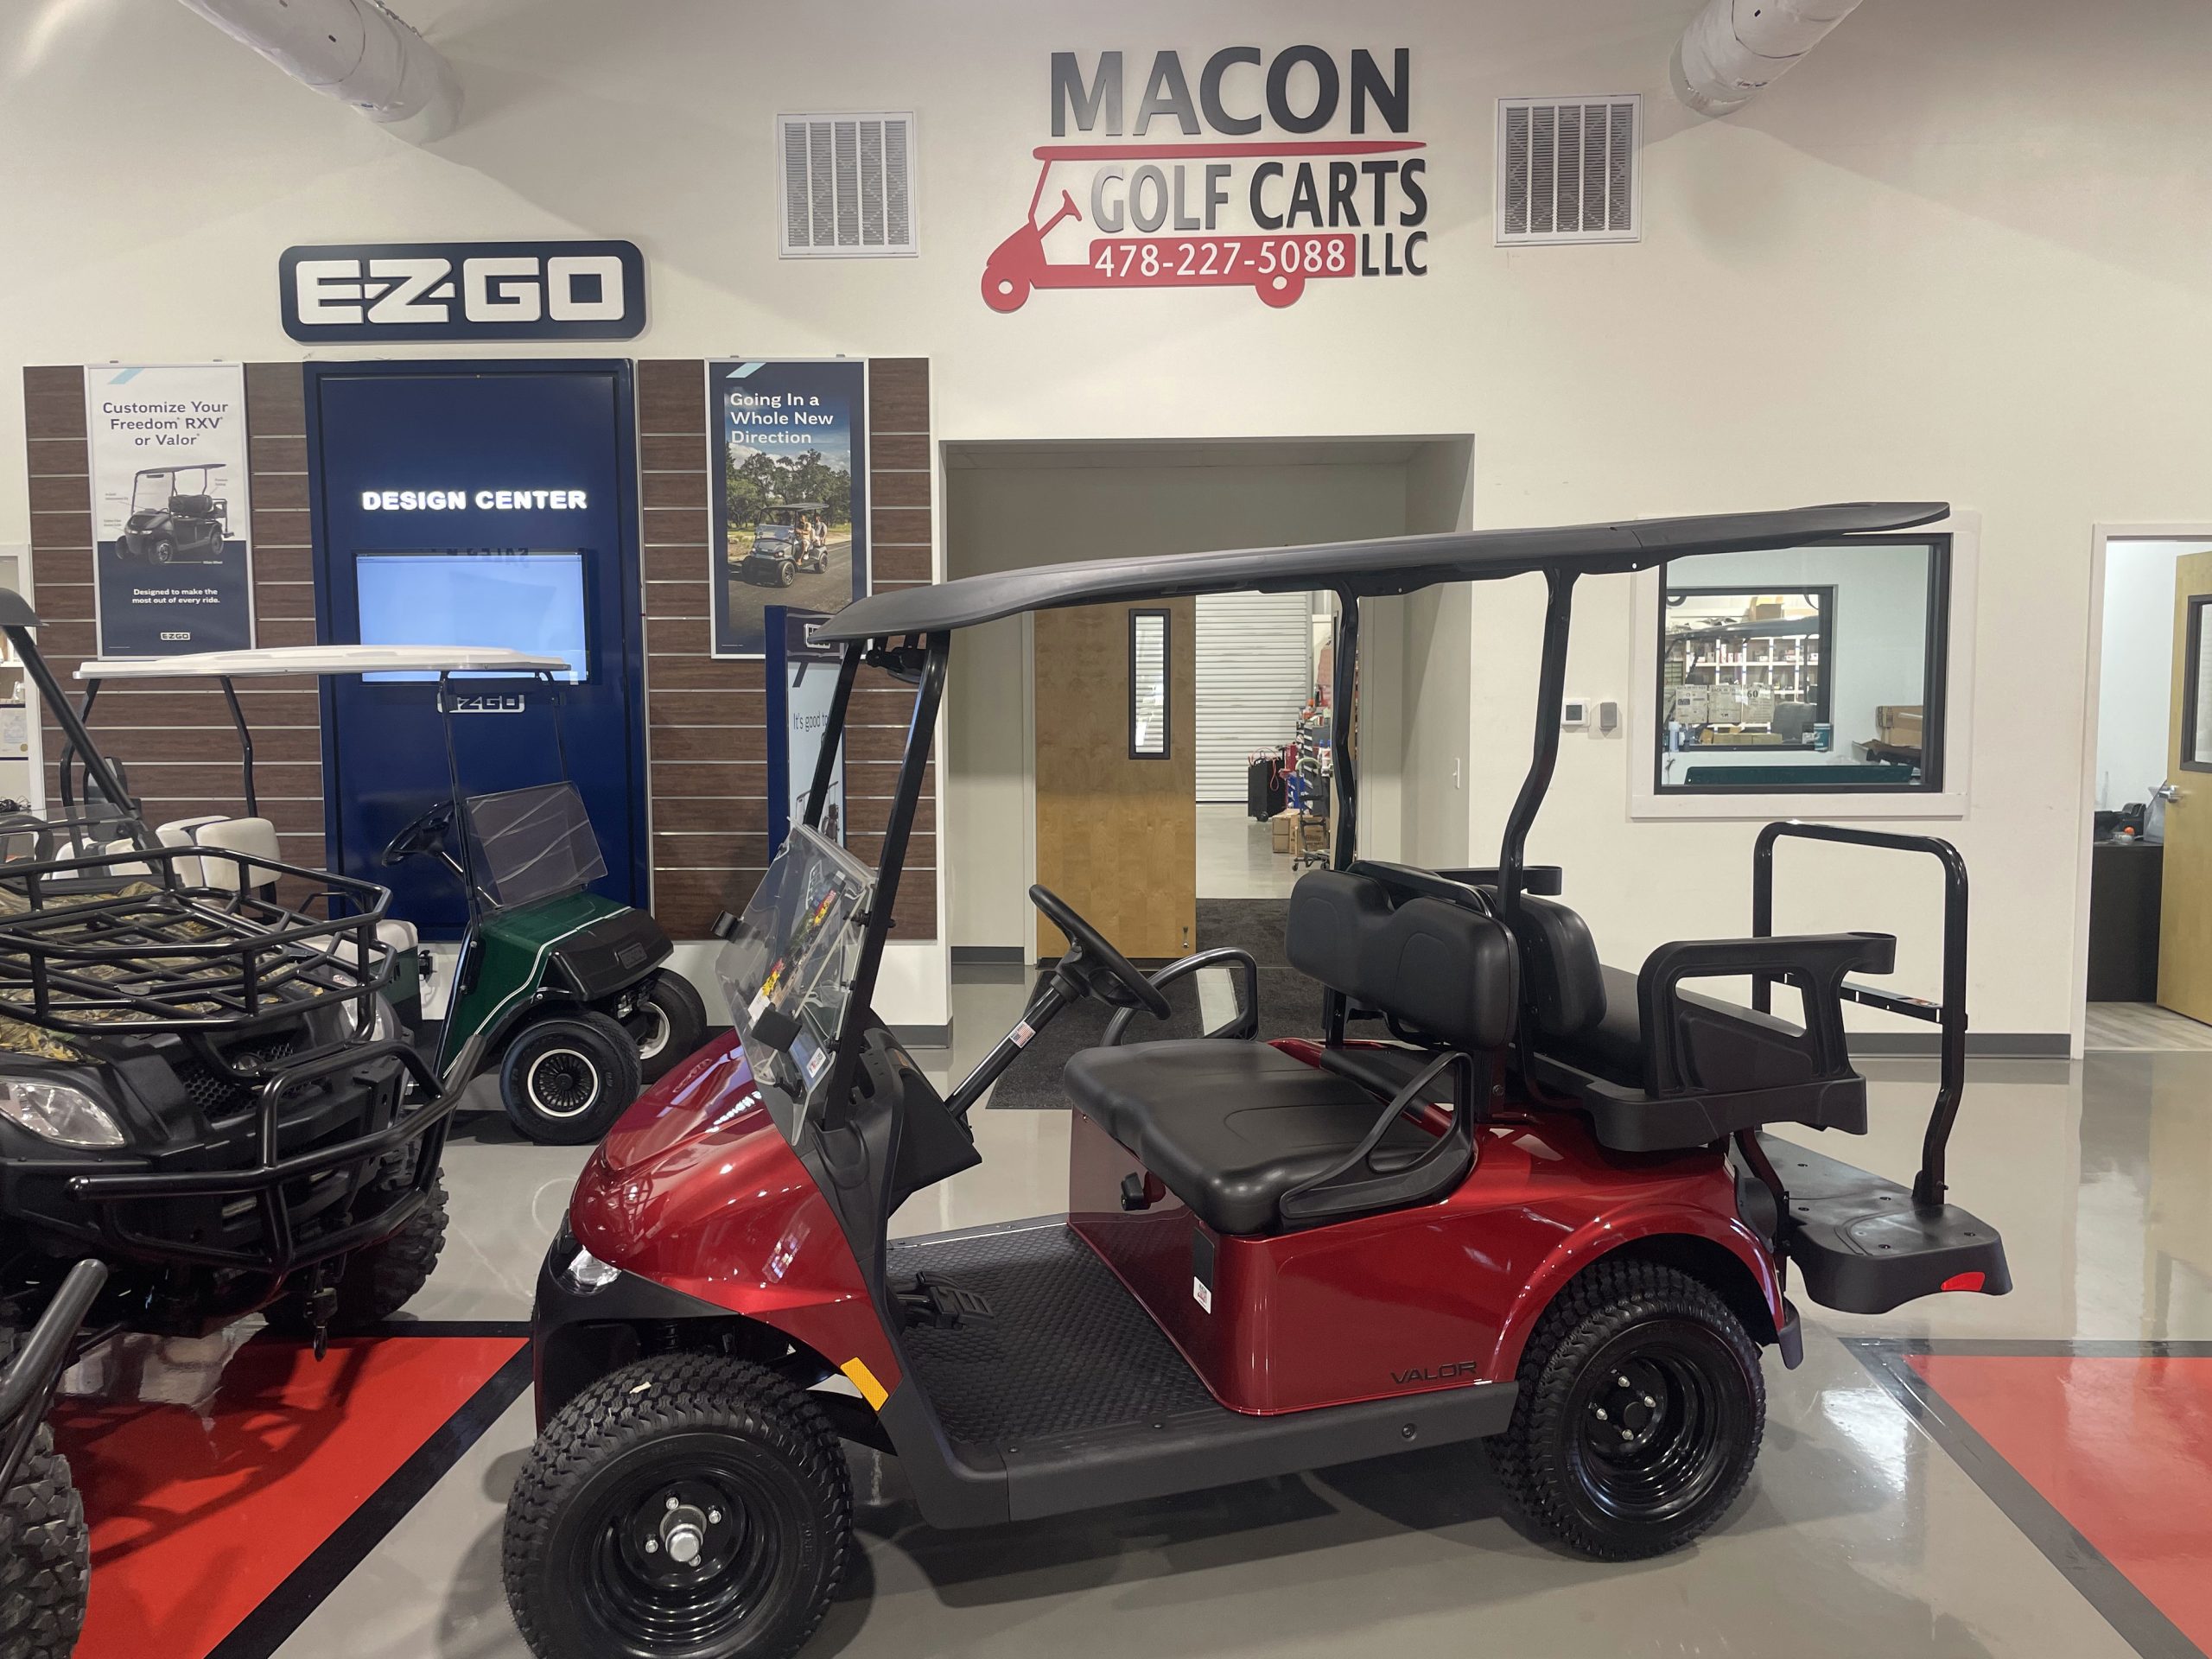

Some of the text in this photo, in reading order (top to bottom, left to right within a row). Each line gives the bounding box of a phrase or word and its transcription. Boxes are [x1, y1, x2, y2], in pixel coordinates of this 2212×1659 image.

[1051, 44, 1410, 137] MACON
[1090, 157, 1428, 233] GOLF CARTS
[1094, 230, 1428, 277] 478-227-5088 LLC
[103, 401, 229, 414] Customize Your
[730, 392, 820, 409] Going In a
[730, 411, 834, 425] Whole New
[135, 437, 151, 446] or
[731, 430, 811, 444] Direction
[362, 489, 588, 511] DESIGN CENTER
[133, 588, 170, 597] Designed
[793, 712, 804, 729] It's
[805, 710, 821, 732] good
[1390, 1361, 1477, 1384] VALOR
